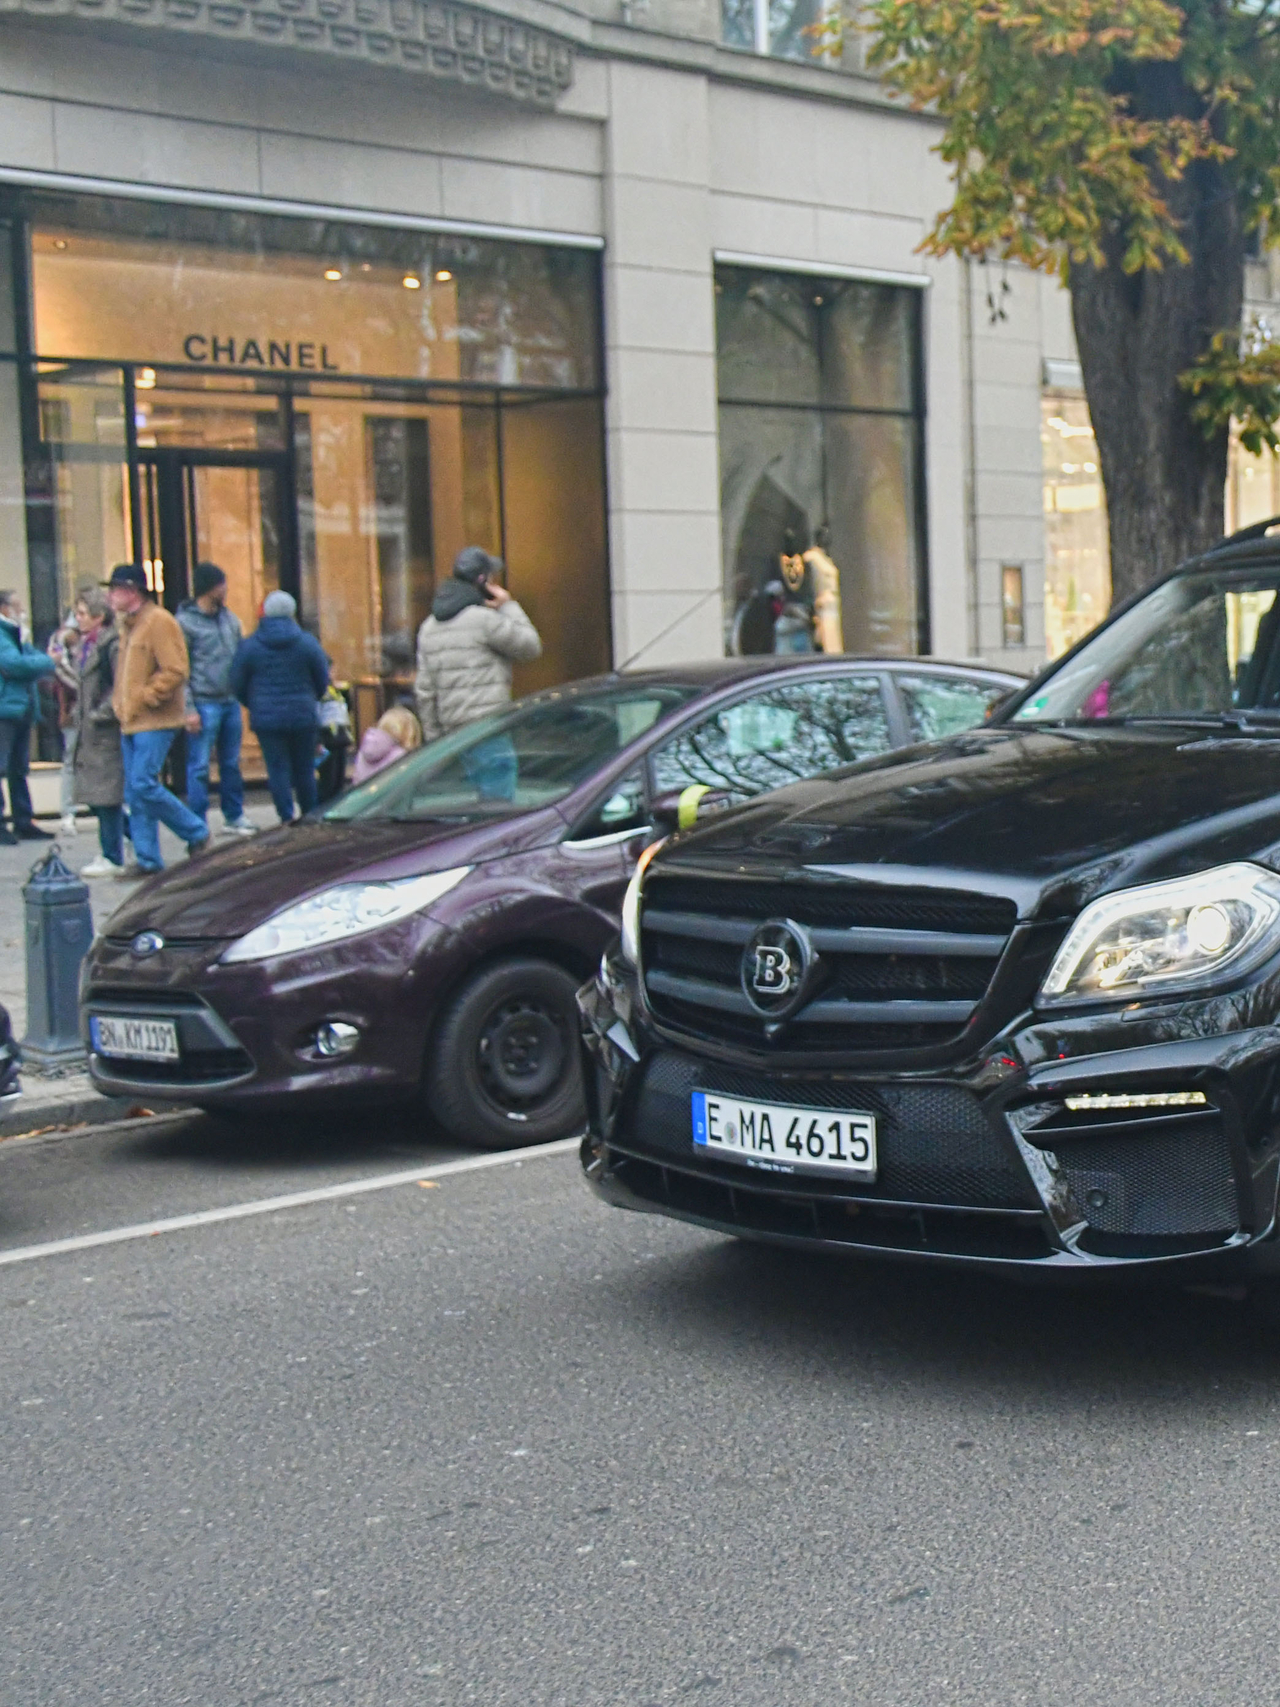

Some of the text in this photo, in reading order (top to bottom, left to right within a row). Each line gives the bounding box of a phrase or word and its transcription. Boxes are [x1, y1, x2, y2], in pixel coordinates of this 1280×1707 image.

[183, 333, 339, 370] CHANEL
[708, 1103, 869, 1162] E MA 4615
